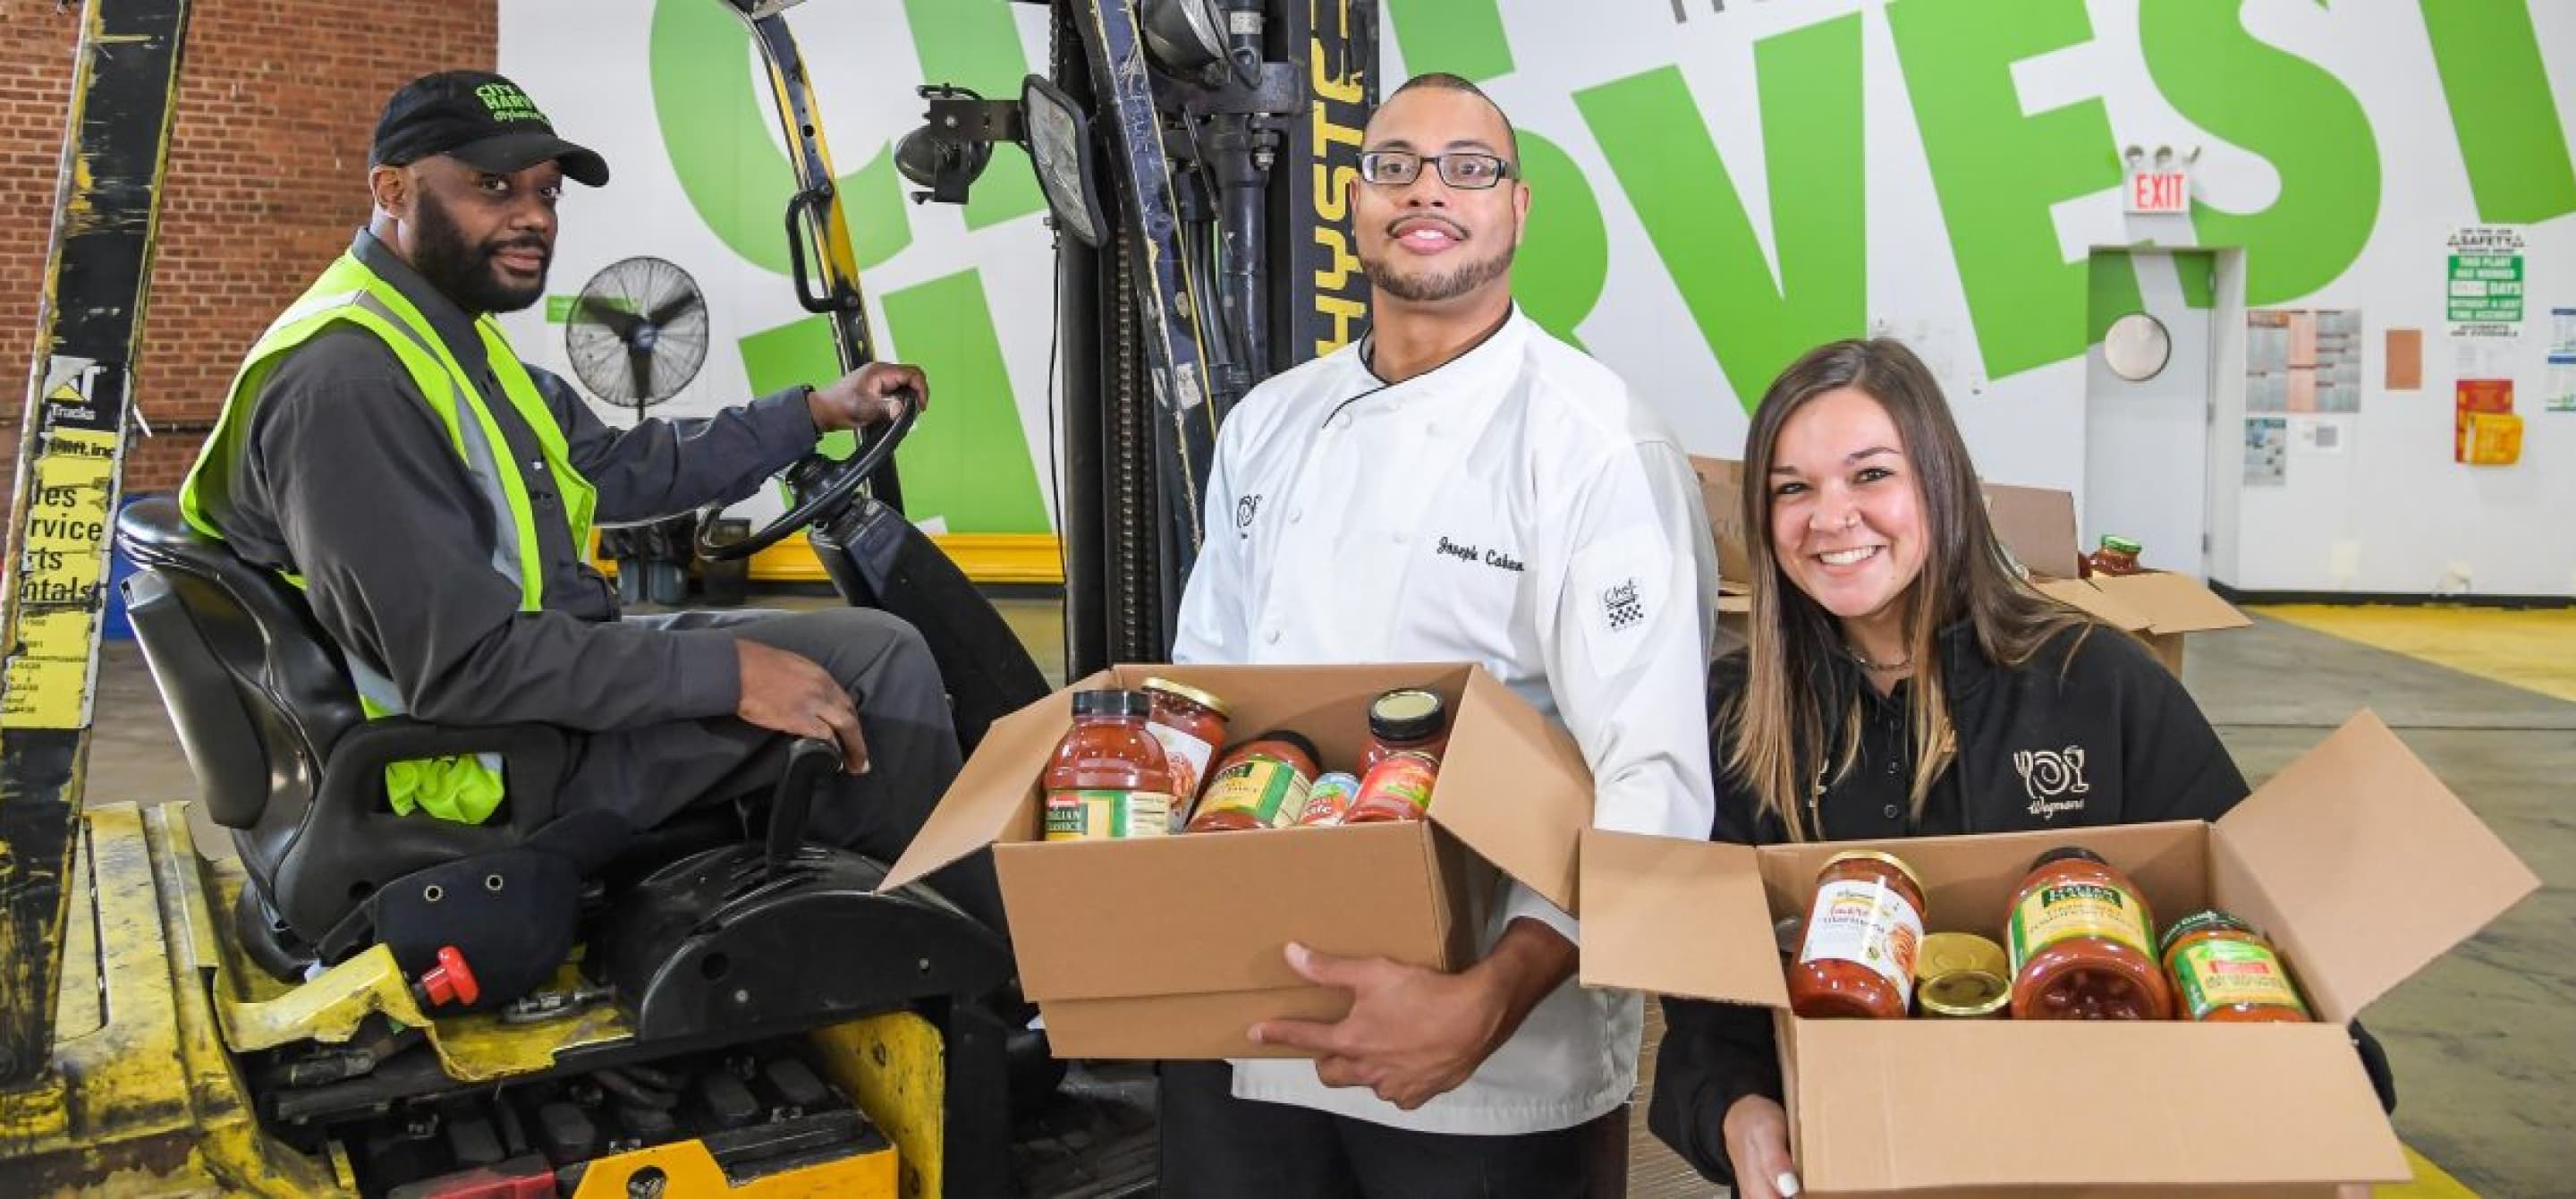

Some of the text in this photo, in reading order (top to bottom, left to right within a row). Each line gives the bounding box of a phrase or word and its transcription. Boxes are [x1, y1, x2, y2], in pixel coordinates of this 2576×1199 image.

[1310, 0, 1367, 358] HYSTE
[2136, 172, 2184, 208] EXIT
[2461, 235, 2512, 246] SAFETY
[1436, 536, 1479, 562] Joseph
[1605, 578, 1639, 603] Chef
[2027, 795, 2085, 821] Wegmans
